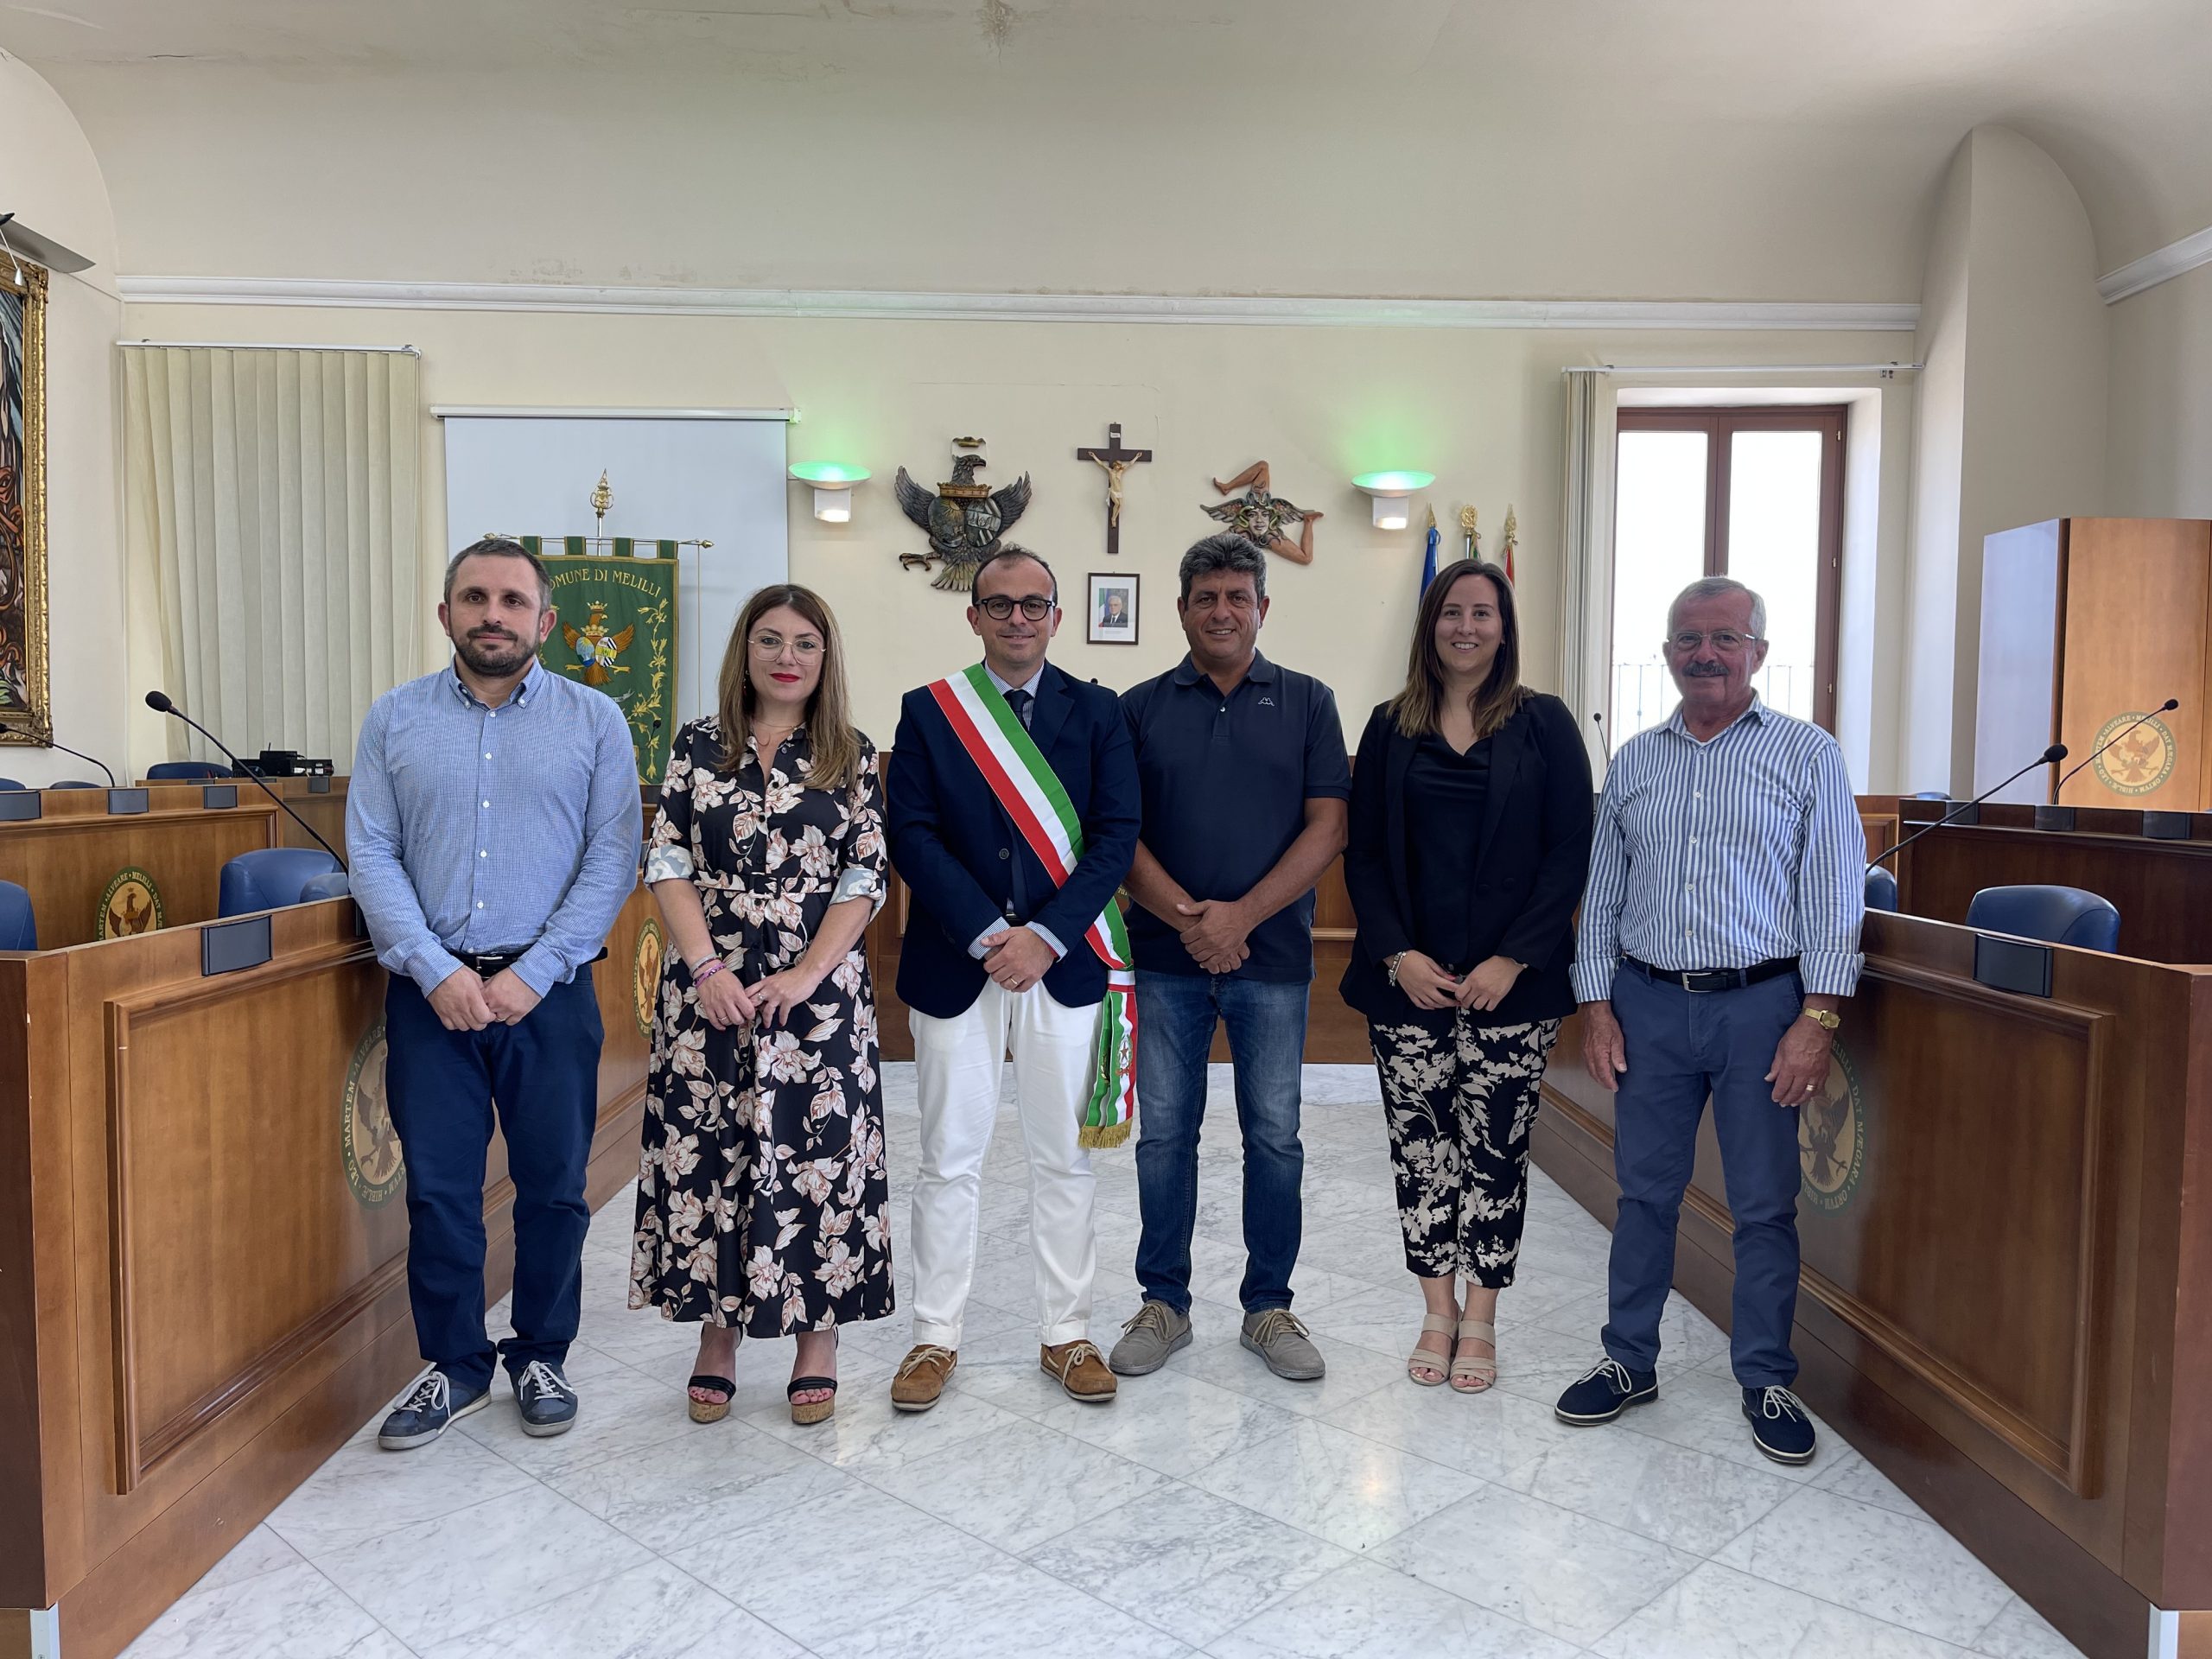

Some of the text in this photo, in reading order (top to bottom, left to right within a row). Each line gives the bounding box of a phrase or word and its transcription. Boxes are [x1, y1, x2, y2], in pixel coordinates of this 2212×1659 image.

[550, 568, 661, 598] OMUNE DI MELILLI
[106, 873, 128, 899] ALVEARE
[131, 871, 153, 890] MELILLI
[1832, 1039, 1852, 1073] ELILLI
[1853, 1084, 1863, 1114] DAT
[345, 1080, 356, 1148] MARTEM
